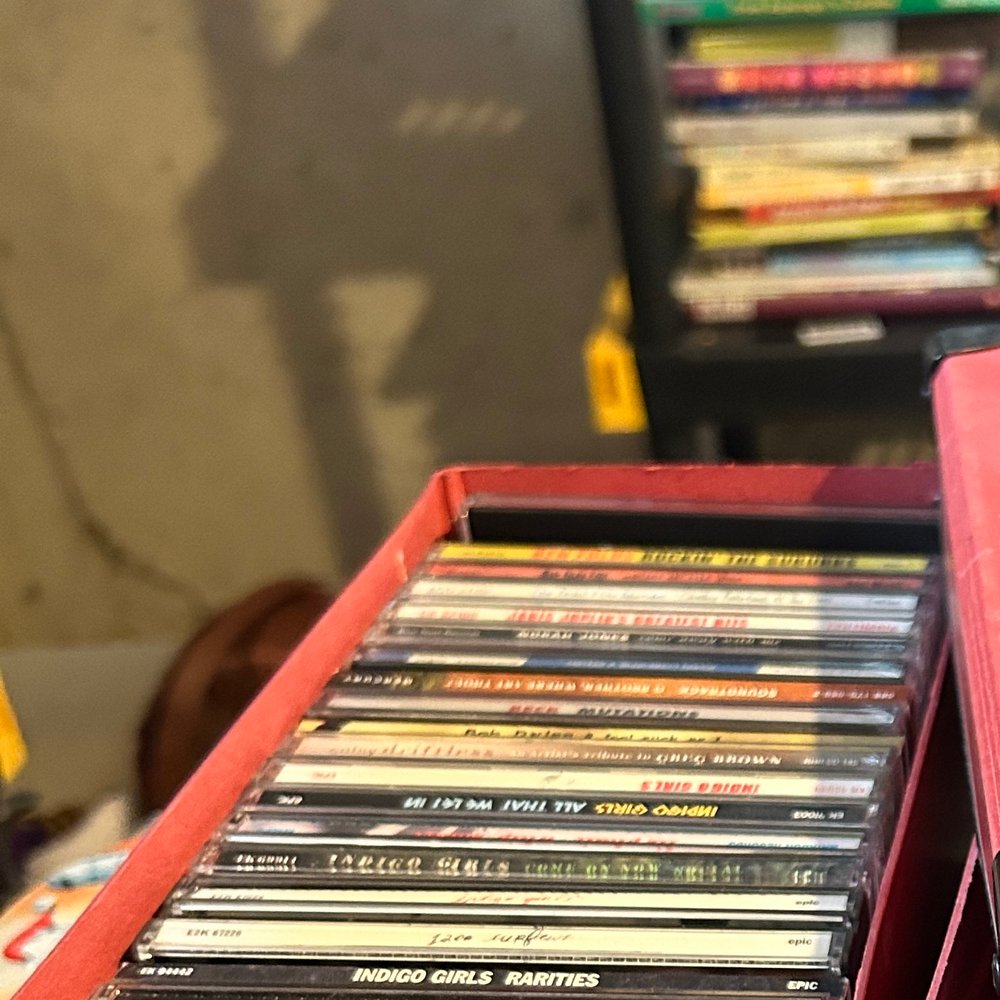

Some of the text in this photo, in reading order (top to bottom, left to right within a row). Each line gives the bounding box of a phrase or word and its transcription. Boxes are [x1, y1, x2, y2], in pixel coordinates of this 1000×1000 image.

[578, 707, 699, 719] MUTATIONS
[640, 781, 760, 796] INDIGO GIRLS
[503, 798, 550, 812] THAT
[553, 800, 588, 812] ALL
[592, 801, 649, 817] GIRLS
[652, 803, 719, 819] INDIGO
[787, 937, 813, 946] epic
[351, 967, 601, 988] INDIGO GIRLS RARITIES
[786, 979, 819, 991] EPIC
